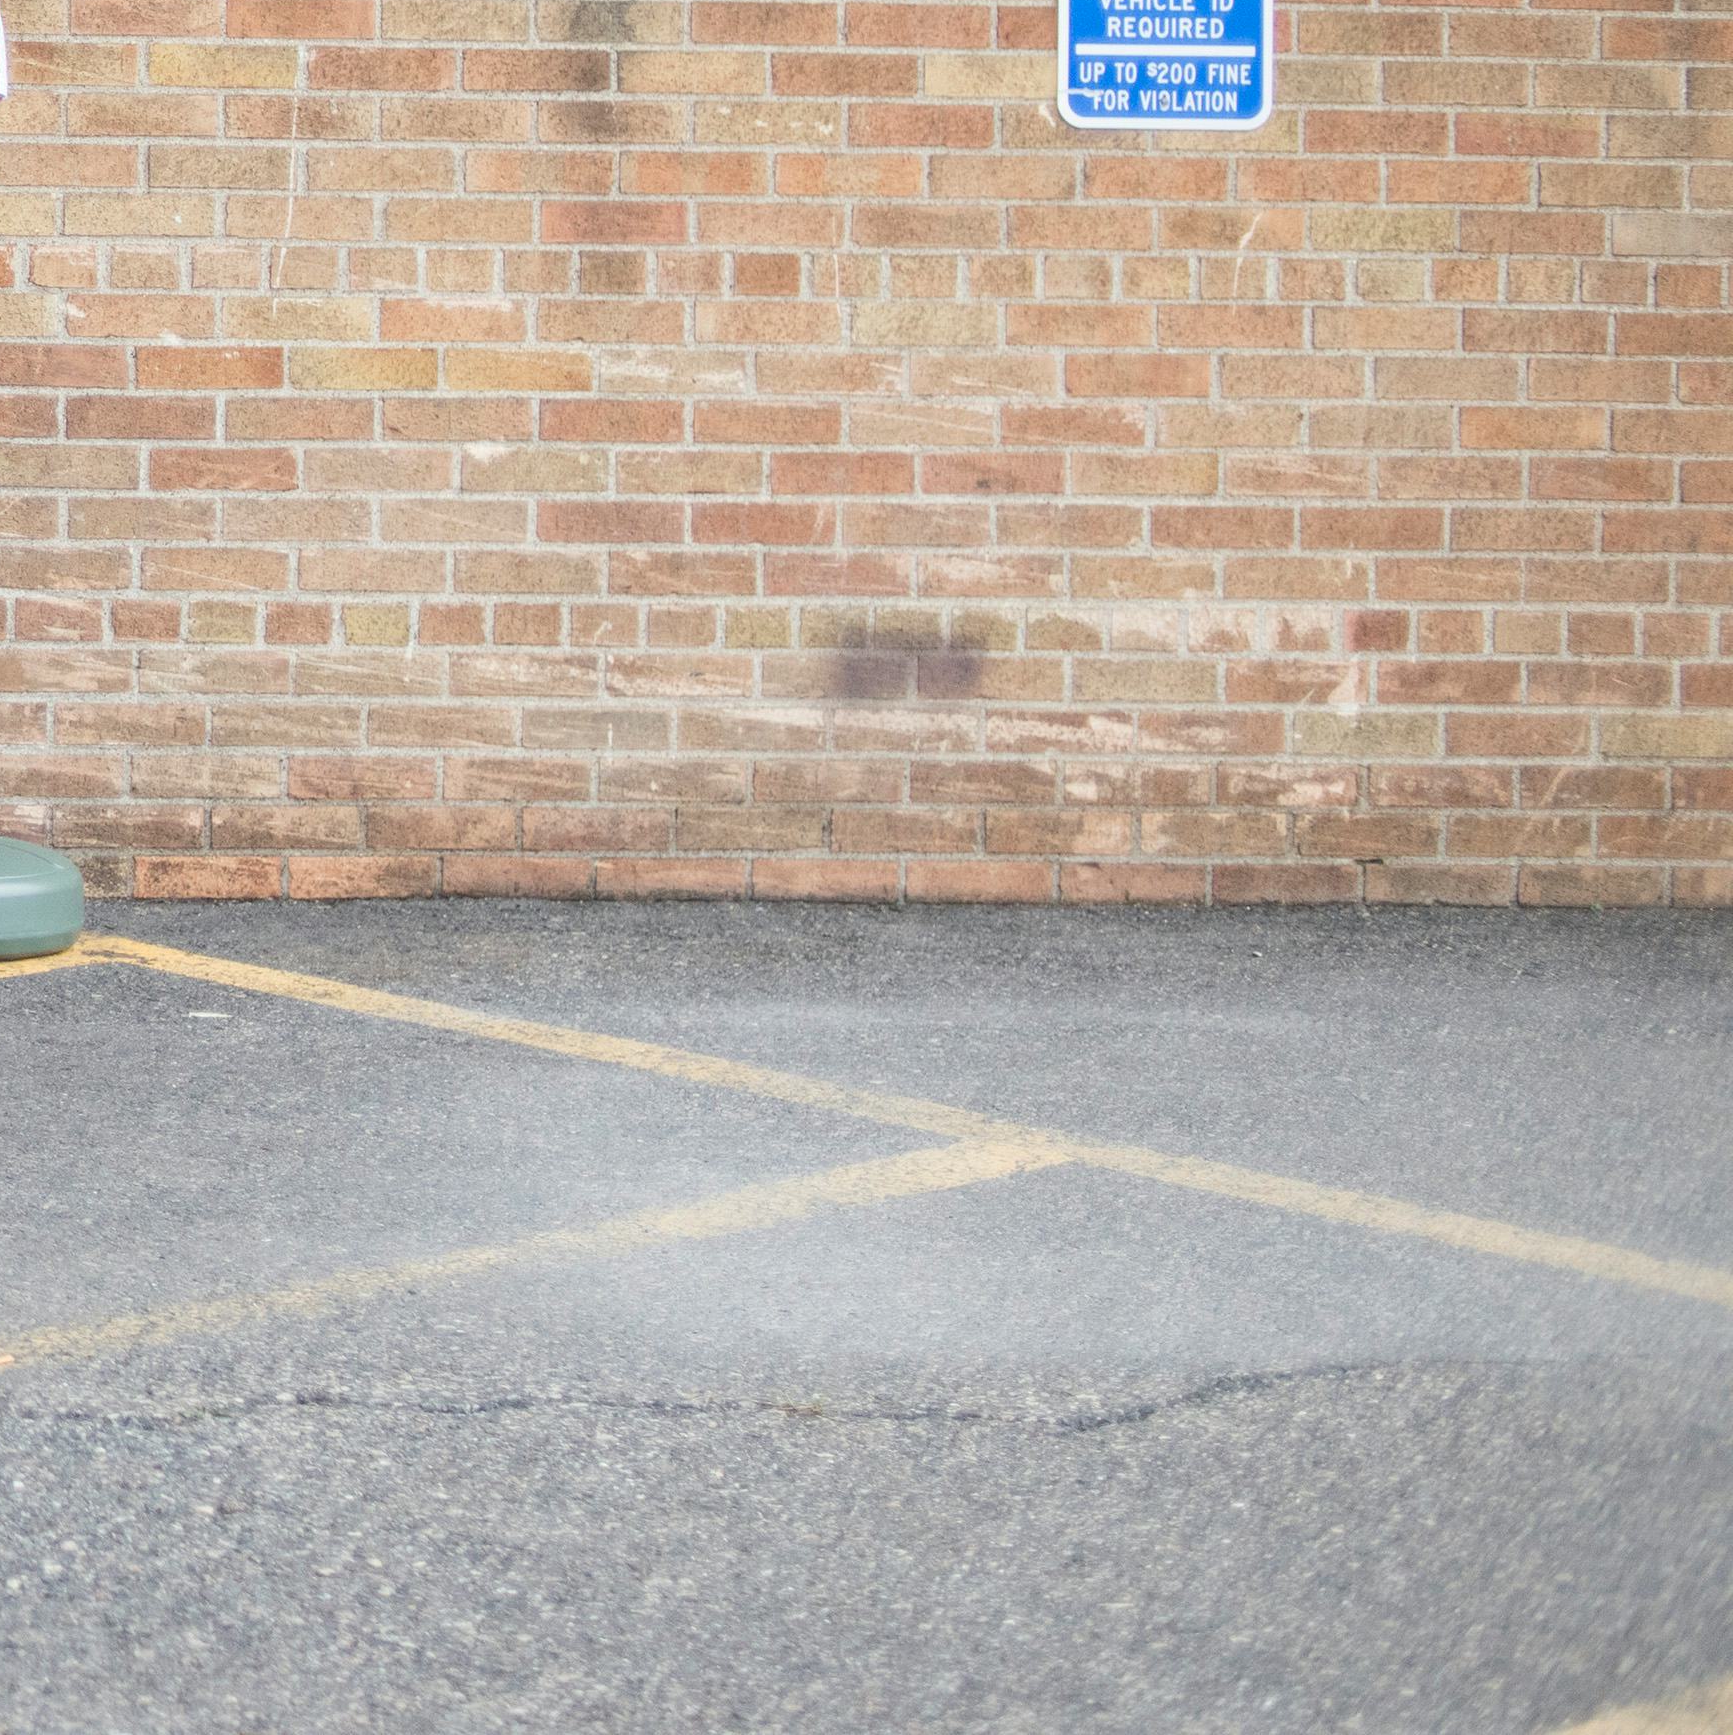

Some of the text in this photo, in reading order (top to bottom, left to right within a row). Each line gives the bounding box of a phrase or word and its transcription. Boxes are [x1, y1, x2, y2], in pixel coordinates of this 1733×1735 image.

[1107, 16, 1225, 40] REQUIRED
[1079, 60, 1106, 84] UP
[1113, 61, 1138, 84] TO
[1207, 62, 1252, 86] FINE
[1139, 89, 1238, 113] VIOLATION
